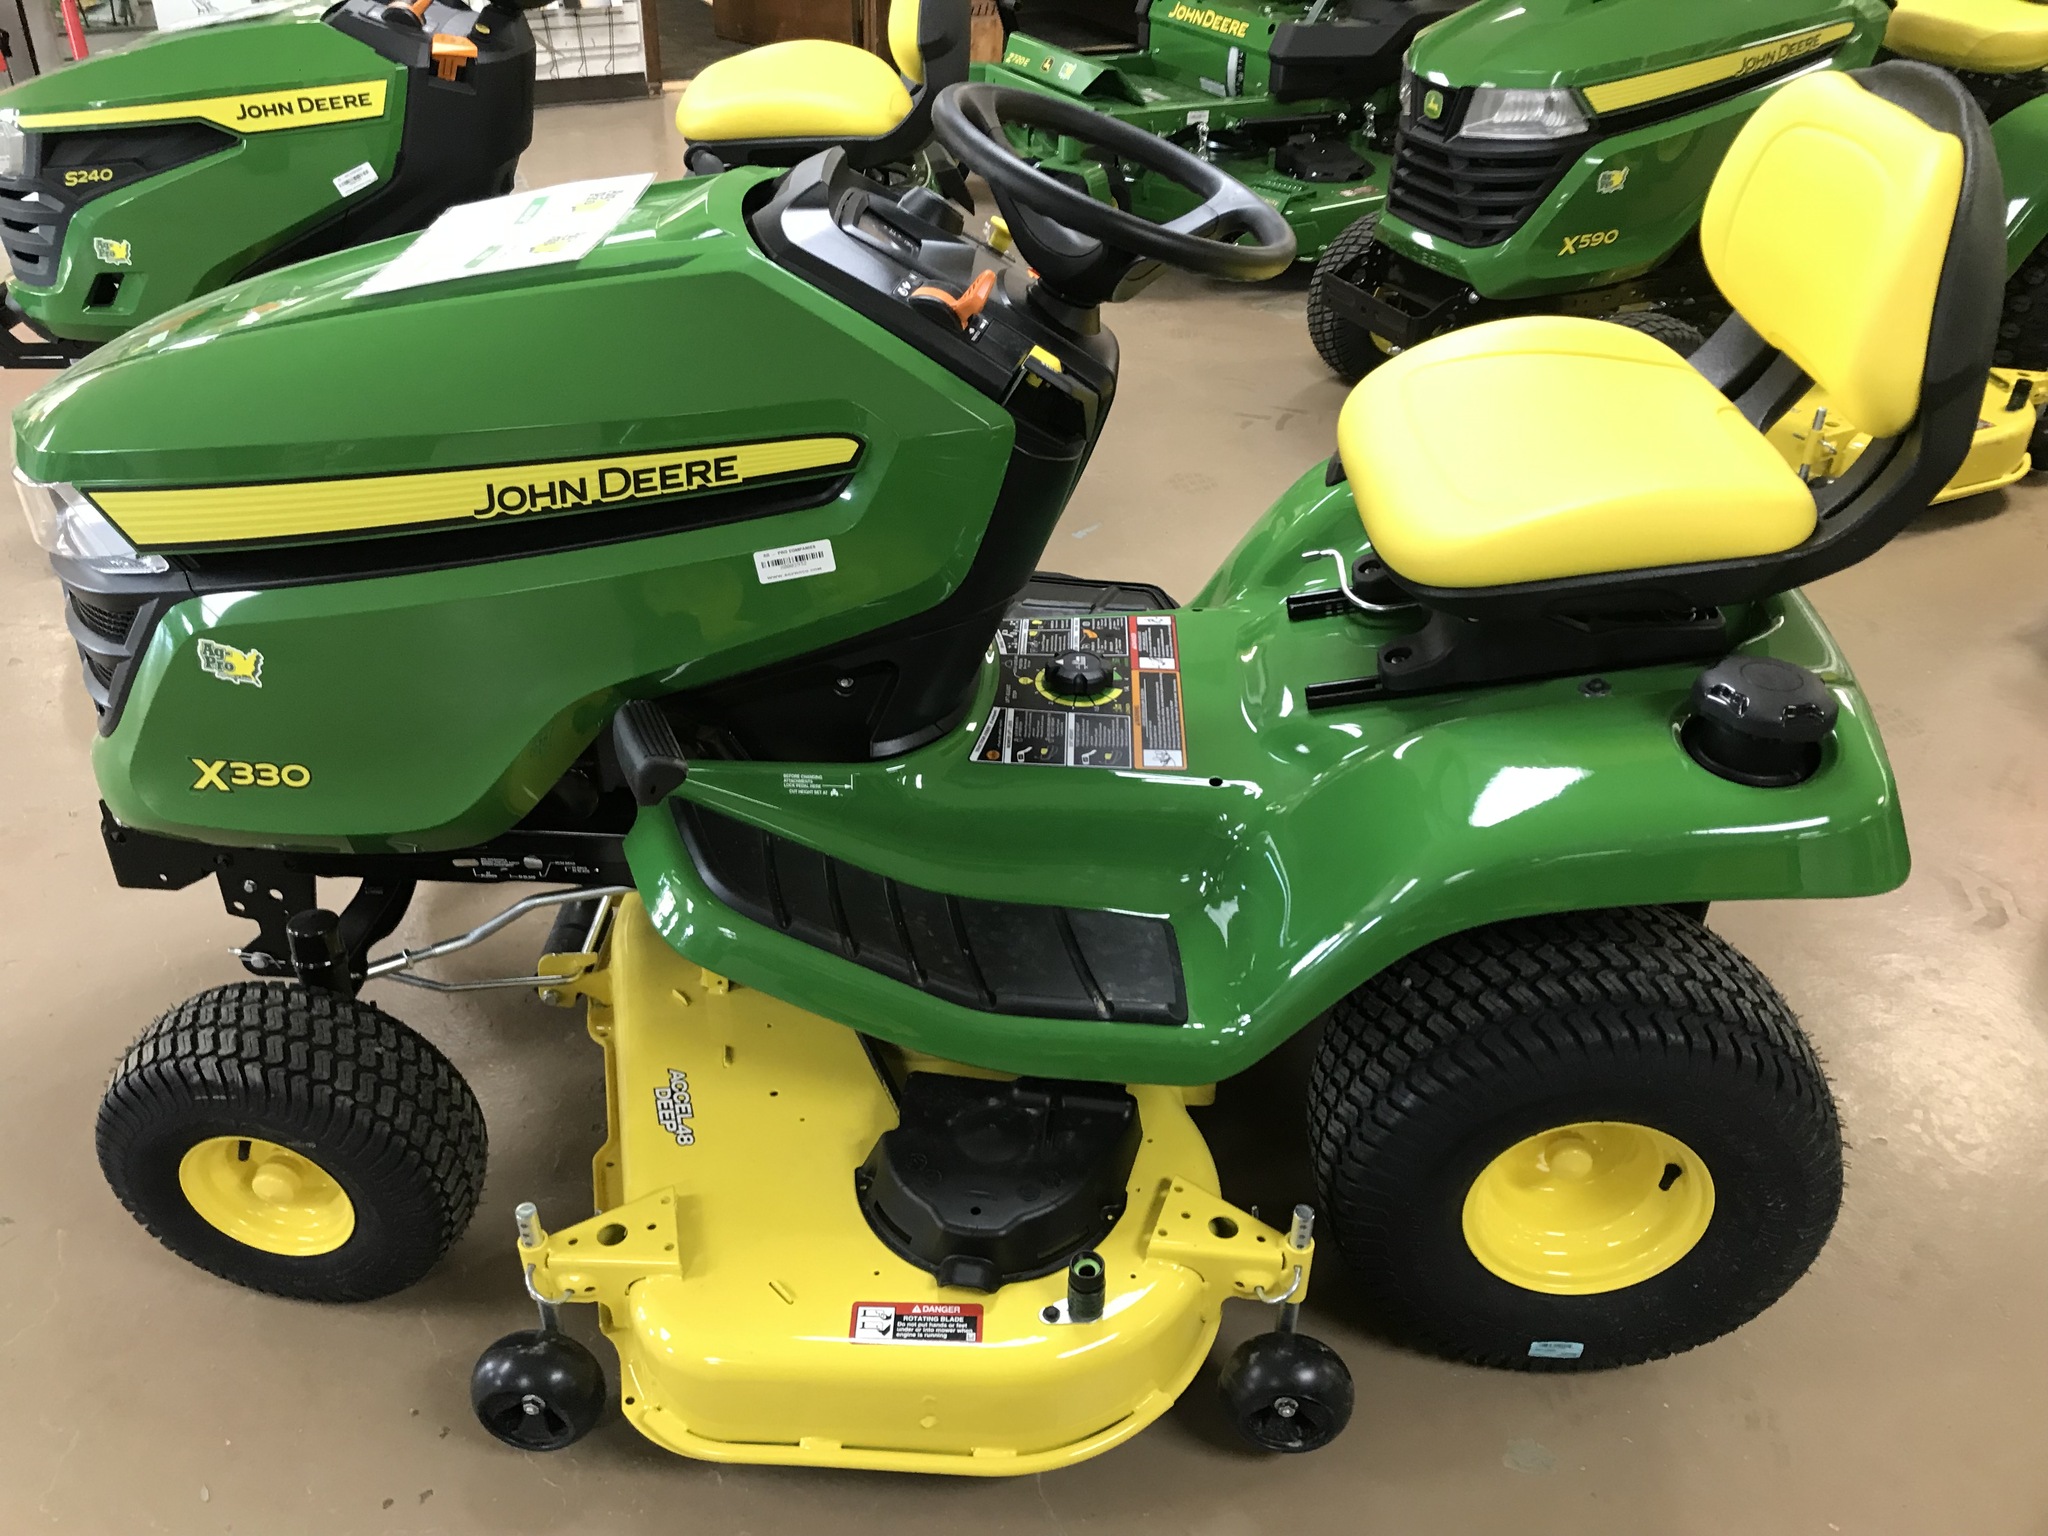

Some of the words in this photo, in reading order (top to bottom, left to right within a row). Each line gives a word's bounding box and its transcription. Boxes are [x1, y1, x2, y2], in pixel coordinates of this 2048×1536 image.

[1168, 1, 1205, 26] JOHN
[1202, 9, 1249, 38] DEERE
[1735, 50, 1777, 77] JOHN
[1778, 33, 1822, 60] DEERE
[236, 102, 294, 120] JOHN
[297, 92, 373, 113] DEERE
[65, 168, 113, 187] S240
[1557, 228, 1620, 257] X590
[473, 476, 591, 518] JOHN
[598, 455, 741, 501] DEERE
[189, 757, 311, 792] X330
[653, 1087, 678, 1134] DEEP
[921, 1305, 961, 1314] DANGER
[924, 1332, 948, 1340] running
